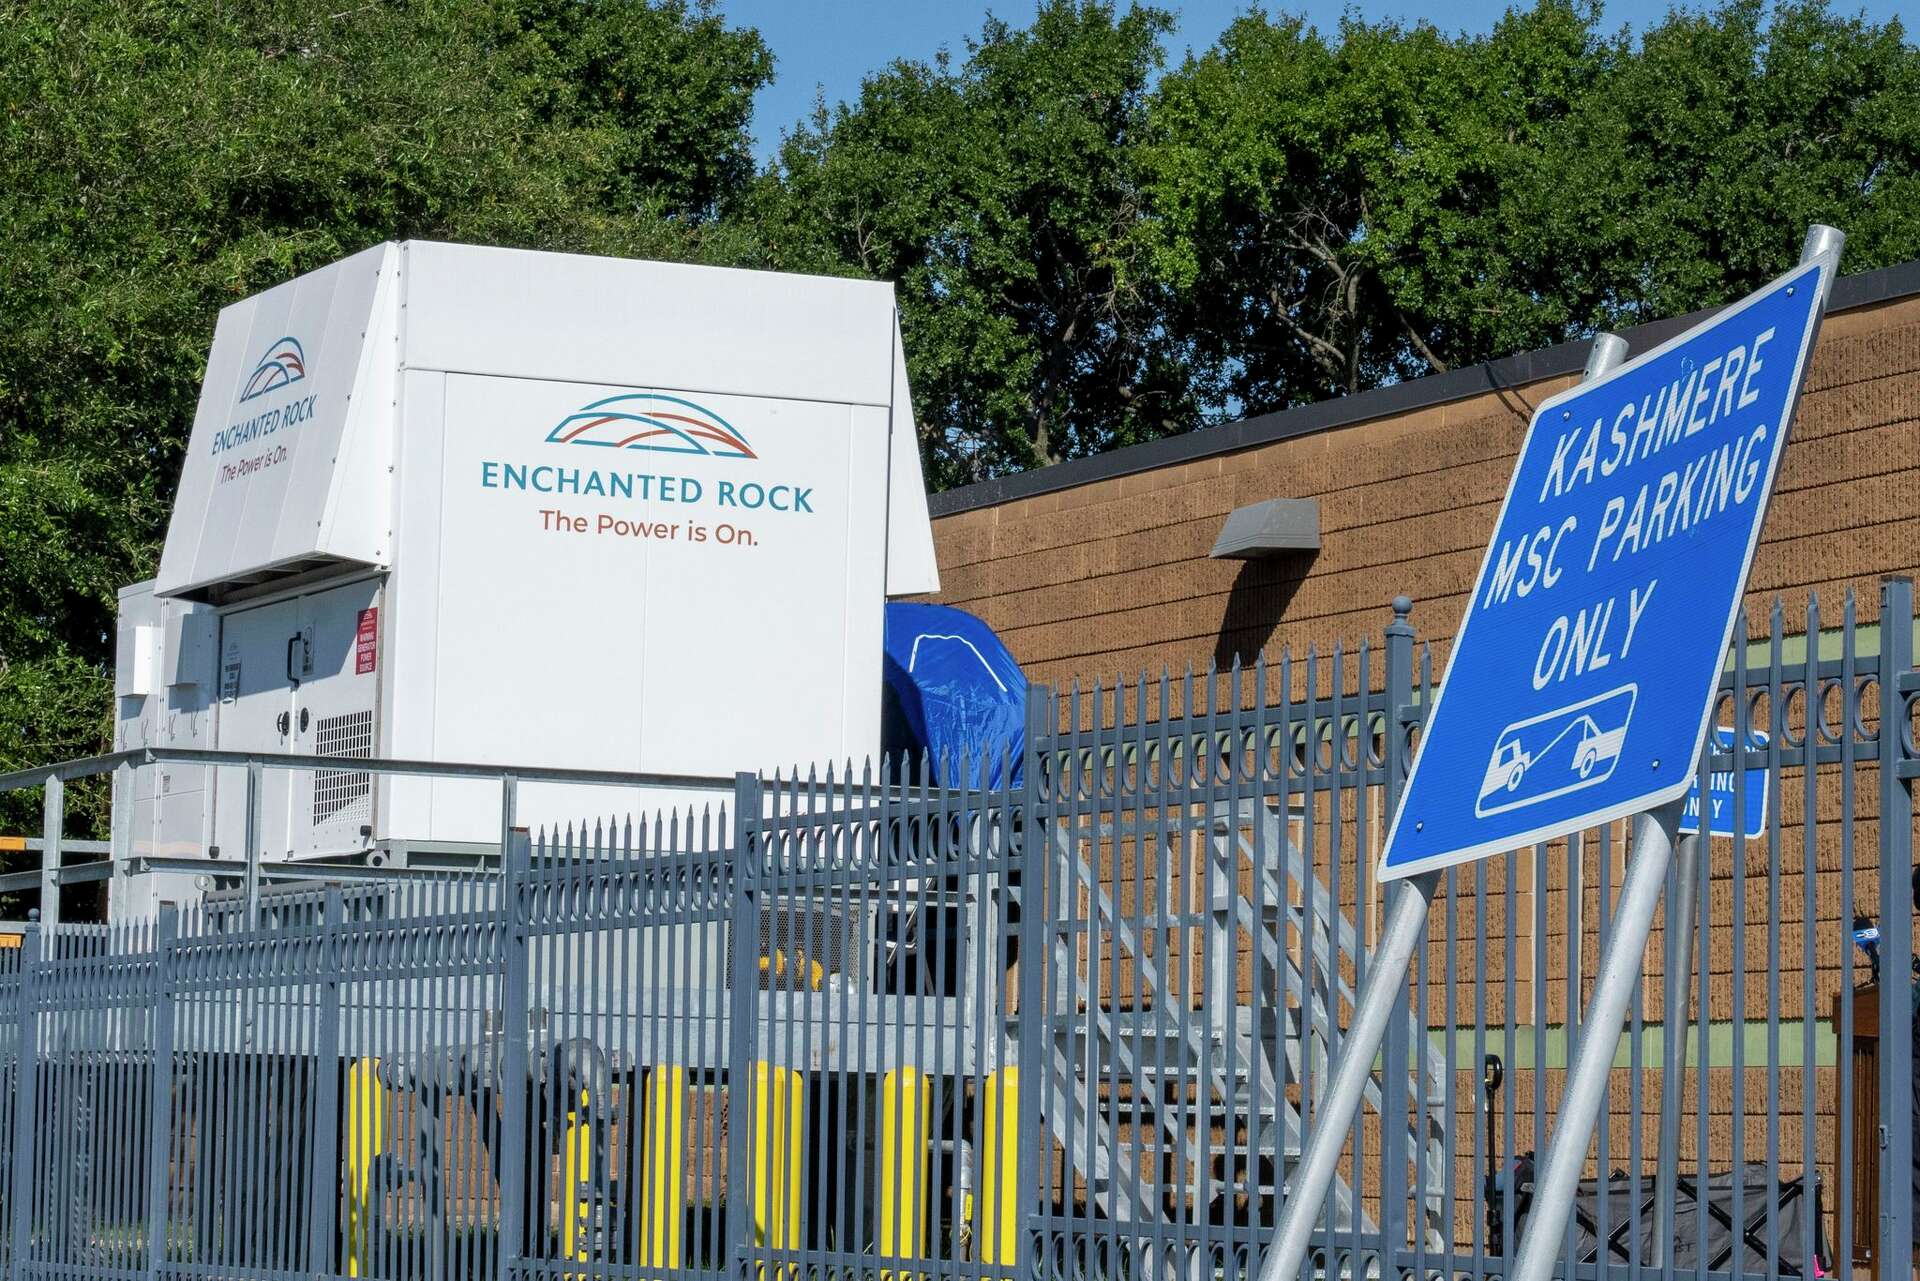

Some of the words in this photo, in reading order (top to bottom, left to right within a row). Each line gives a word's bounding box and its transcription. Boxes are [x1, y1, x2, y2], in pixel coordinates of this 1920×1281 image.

[212, 409, 280, 455] ENCHANTED
[281, 394, 317, 429] ROCK
[1539, 328, 1776, 503] KASHMERE
[220, 464, 237, 485] The
[237, 455, 264, 478] Power
[264, 448, 272, 469] is
[273, 445, 288, 466] On.
[481, 461, 703, 504] ENCHANTED
[718, 480, 815, 513] ROCK
[539, 509, 589, 534] The
[596, 513, 680, 541] Power
[687, 520, 708, 543] is
[715, 523, 759, 547] On.
[1483, 516, 1577, 609] MSC
[1587, 424, 1767, 572] PARKING
[1532, 580, 1657, 690] ONLY
